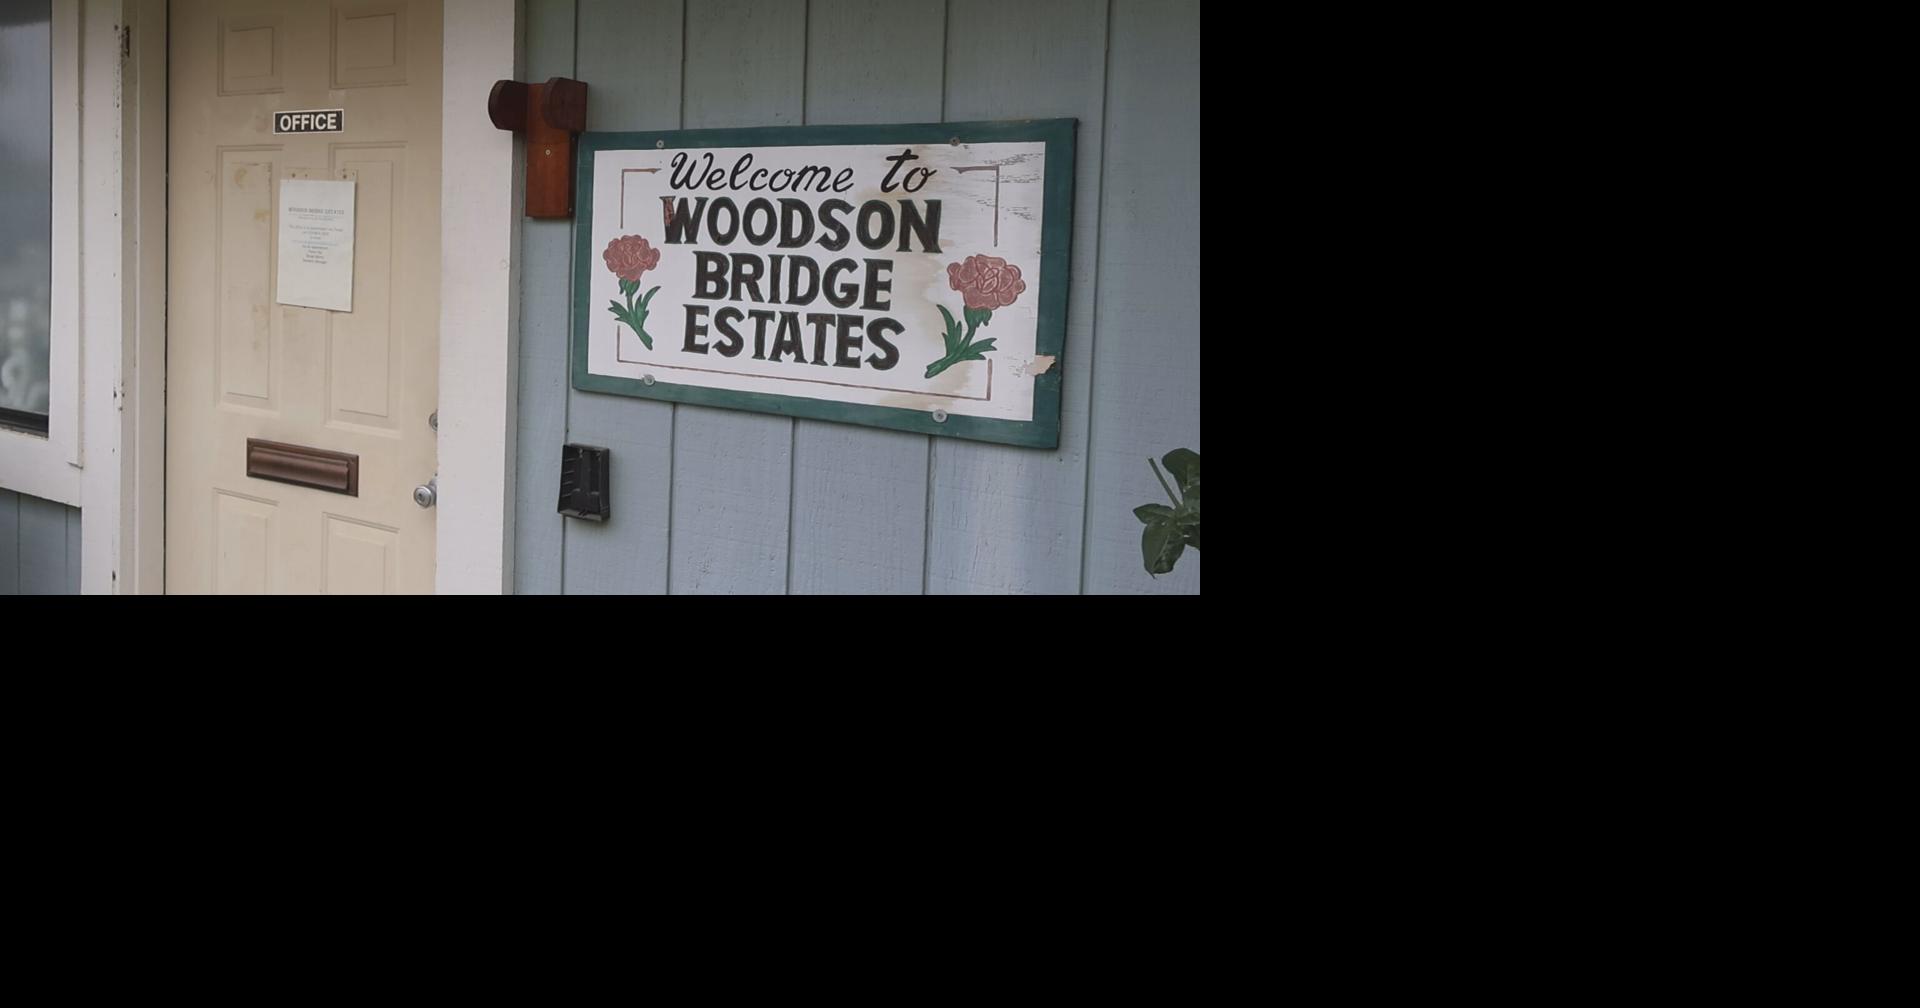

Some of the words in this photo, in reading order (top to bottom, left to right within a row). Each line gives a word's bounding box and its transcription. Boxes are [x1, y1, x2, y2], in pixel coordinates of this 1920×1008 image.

[280, 113, 337, 131] OFFICE
[669, 151, 854, 192] Welcome
[880, 149, 937, 193] to
[660, 195, 942, 254] WOODSON
[692, 250, 894, 311] BRIDGE
[681, 303, 905, 371] ESTATES
